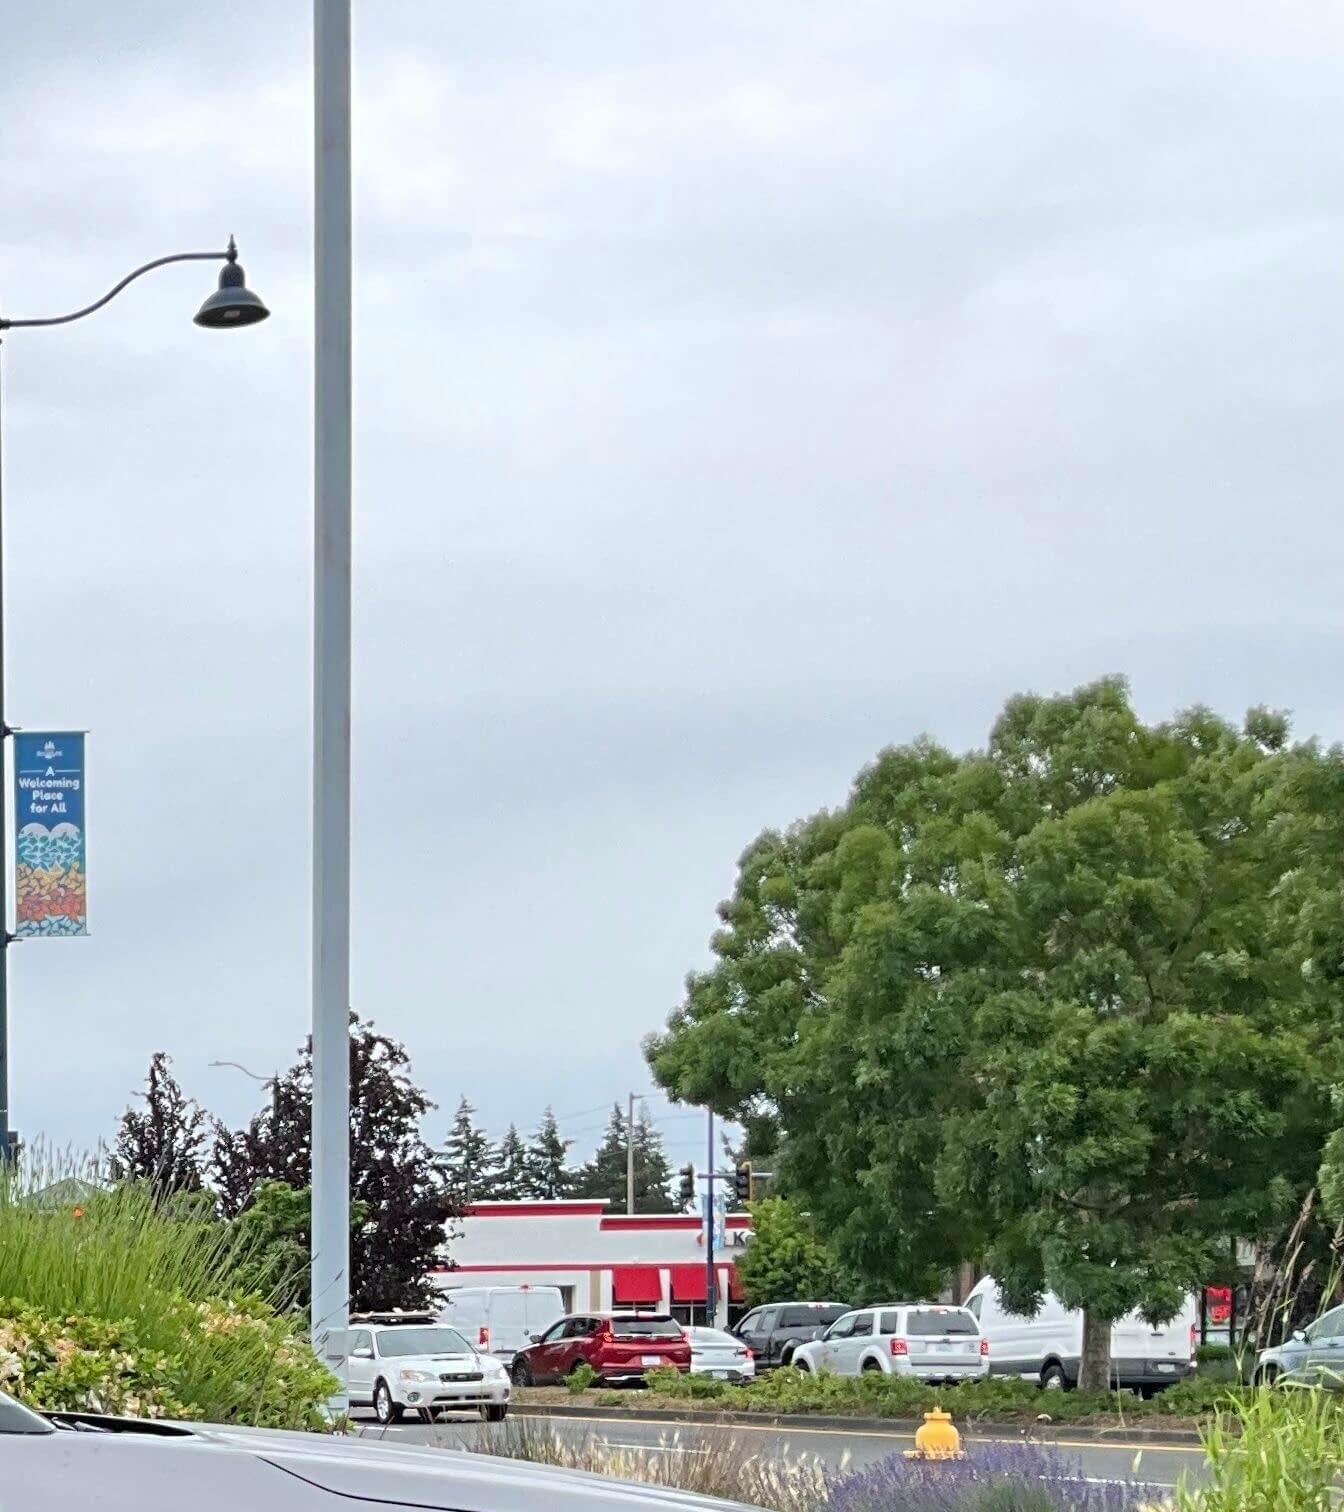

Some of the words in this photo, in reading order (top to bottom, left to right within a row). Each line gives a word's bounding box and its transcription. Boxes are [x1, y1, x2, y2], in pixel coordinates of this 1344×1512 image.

[45, 766, 55, 776] A
[19, 777, 80, 790] Welcoming
[32, 790, 63, 800] Place
[30, 803, 48, 813] for
[51, 802, 67, 813] All
